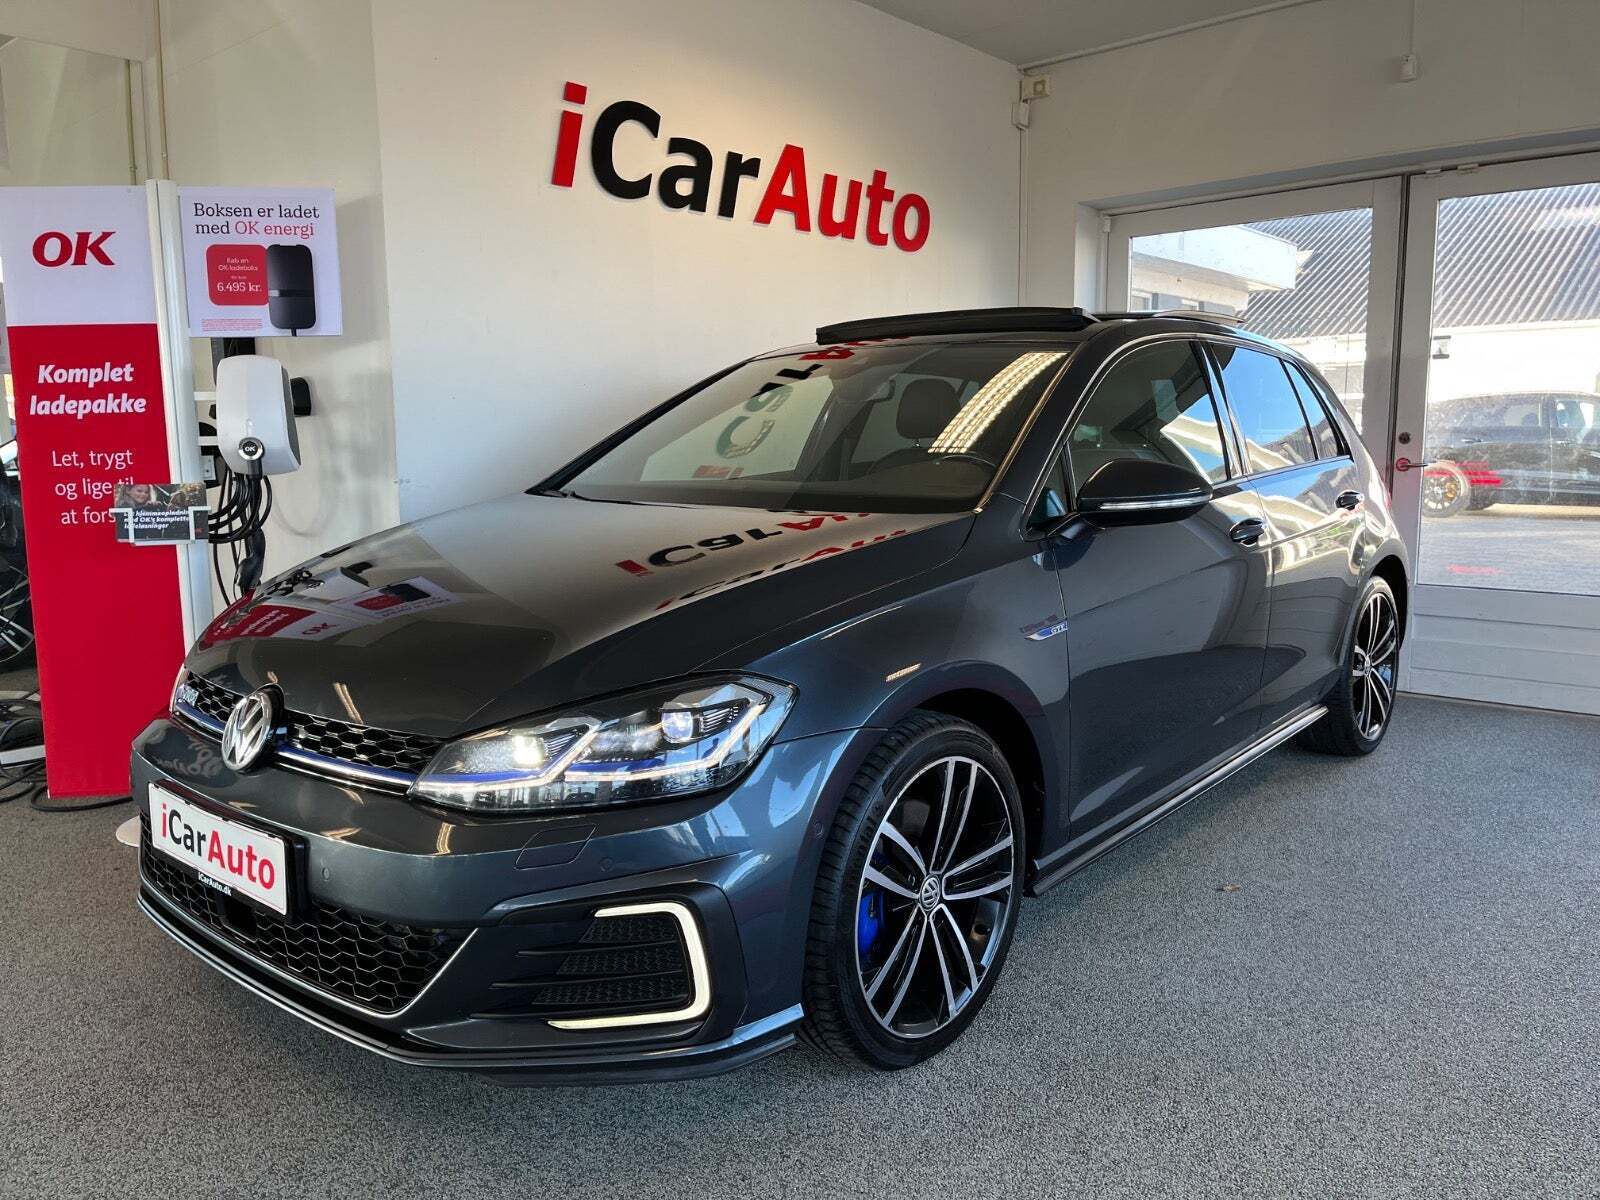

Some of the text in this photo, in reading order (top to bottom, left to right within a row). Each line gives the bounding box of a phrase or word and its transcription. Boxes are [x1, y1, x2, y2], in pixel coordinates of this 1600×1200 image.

[551, 81, 931, 253] iCarAuto
[194, 202, 320, 219] Boksen er ladet
[195, 220, 315, 239] med OK energi
[32, 231, 117, 268] OK
[217, 282, 263, 292] 6.495 kr.
[37, 361, 135, 389] Komplet
[29, 391, 147, 420] ladepakke
[52, 449, 134, 471] Let, trygt
[55, 482, 78, 500] og
[82, 477, 112, 500] lige
[60, 506, 116, 525] at fors
[161, 803, 276, 890] iCarAuto
[198, 871, 232, 897] iCarAuto.dk
